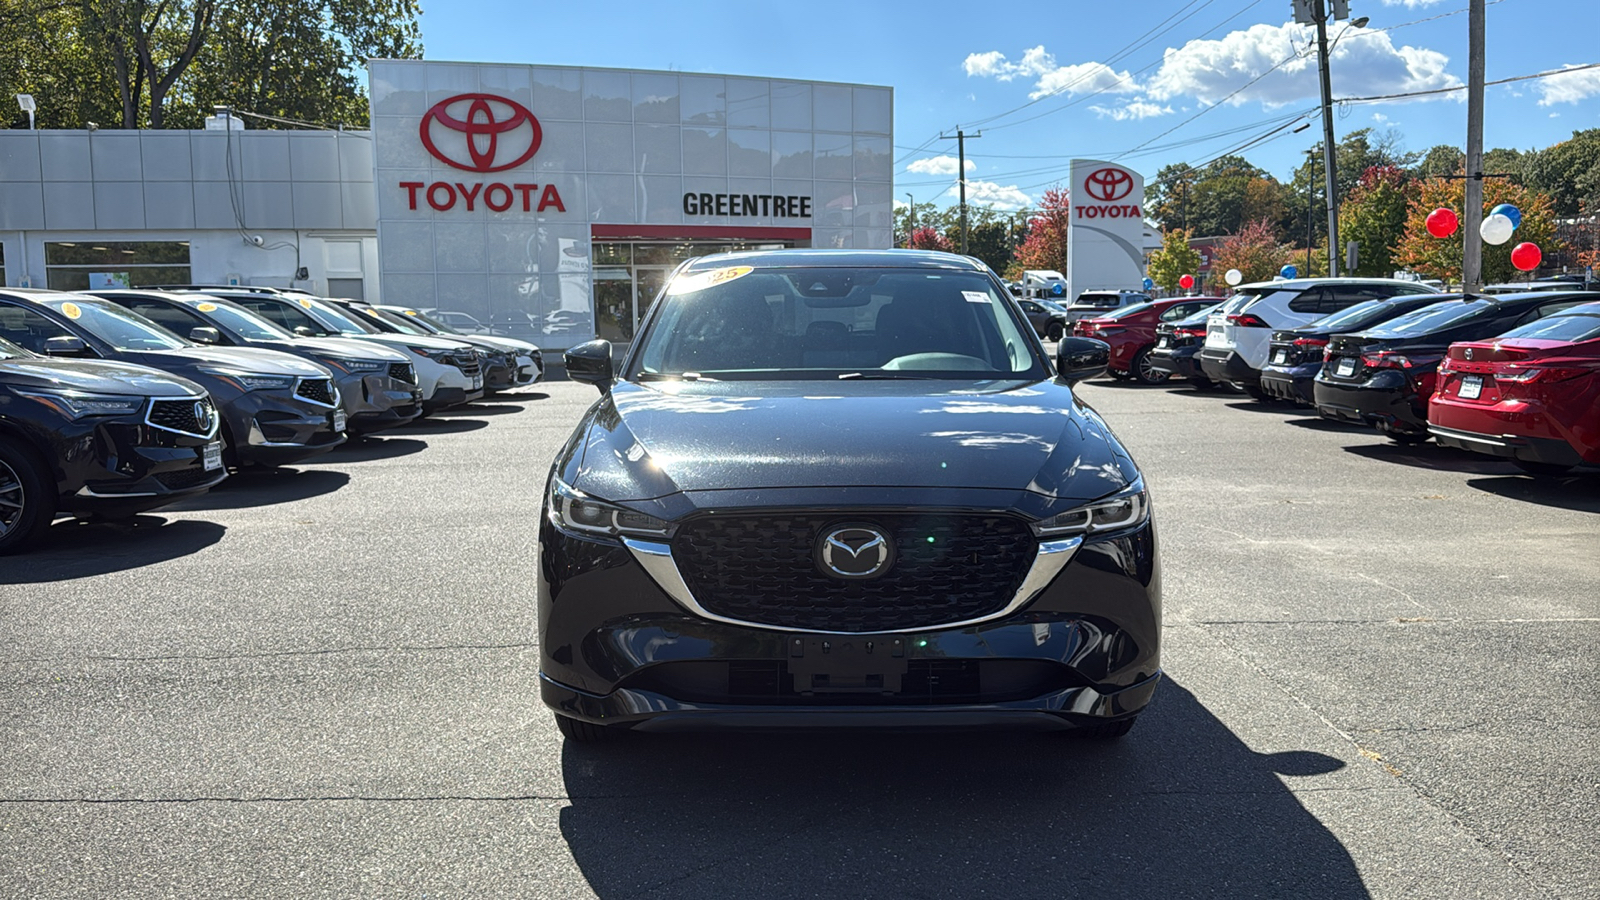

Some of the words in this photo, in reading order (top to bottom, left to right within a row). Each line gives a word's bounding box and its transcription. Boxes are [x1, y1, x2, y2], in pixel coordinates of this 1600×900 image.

[400, 182, 565, 212] TOYOTA
[683, 192, 812, 218] GREENTREE
[1075, 205, 1141, 218] TOYOTA
